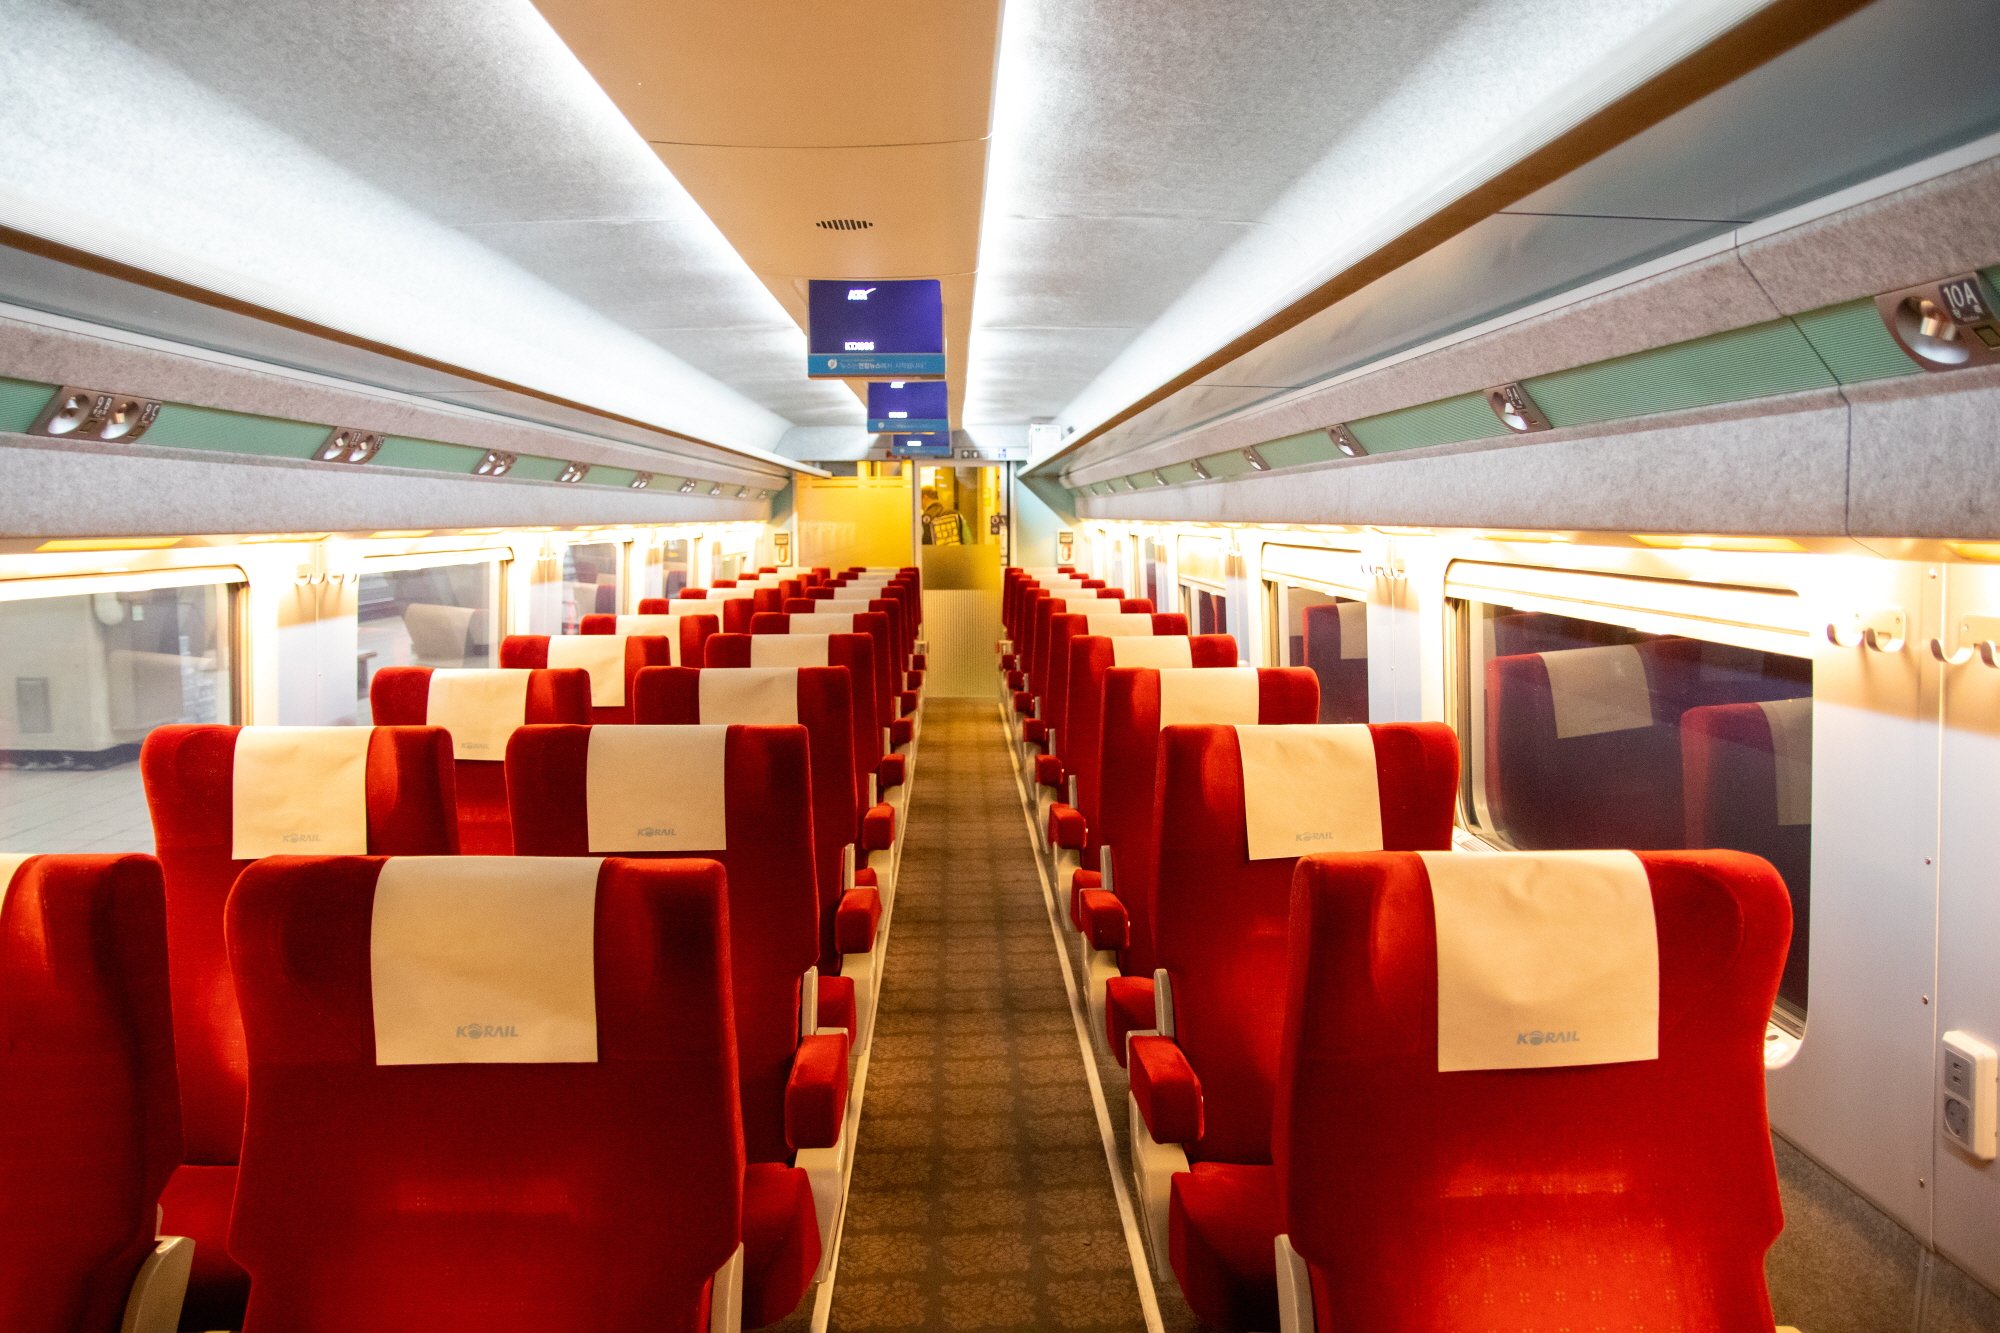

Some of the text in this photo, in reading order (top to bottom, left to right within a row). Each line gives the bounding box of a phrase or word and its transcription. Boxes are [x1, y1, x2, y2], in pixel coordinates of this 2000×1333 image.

[1943, 281, 1979, 308] 10A
[282, 832, 321, 843] KORAIL
[637, 826, 677, 838] KORAIL
[1295, 831, 1335, 842] KORAIL
[456, 1023, 519, 1039] KORAIL
[1516, 1030, 1580, 1046] KORAIL
